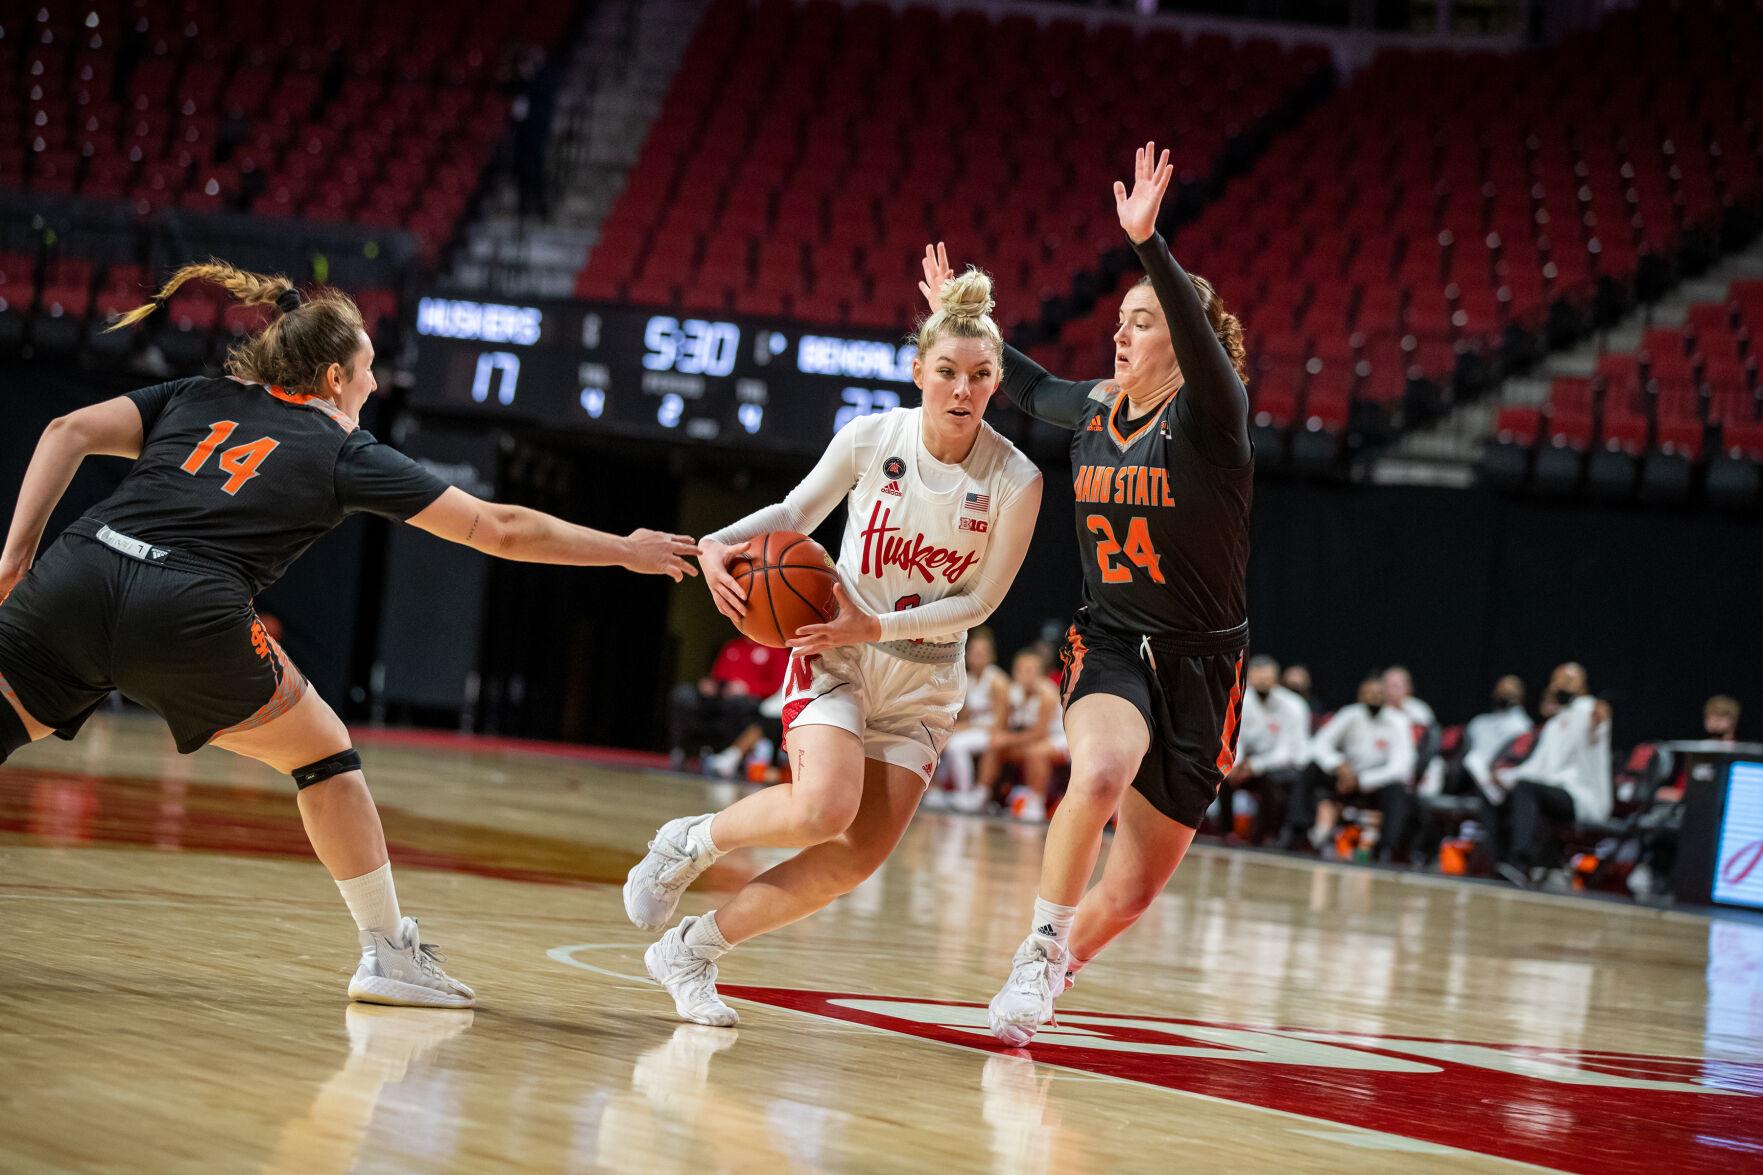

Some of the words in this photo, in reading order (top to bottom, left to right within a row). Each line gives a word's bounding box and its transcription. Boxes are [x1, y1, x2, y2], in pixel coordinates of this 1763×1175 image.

[180, 420, 280, 496] 14
[1114, 466, 1175, 507] STATE
[861, 500, 980, 583] Huskers
[1087, 514, 1166, 584] 24
